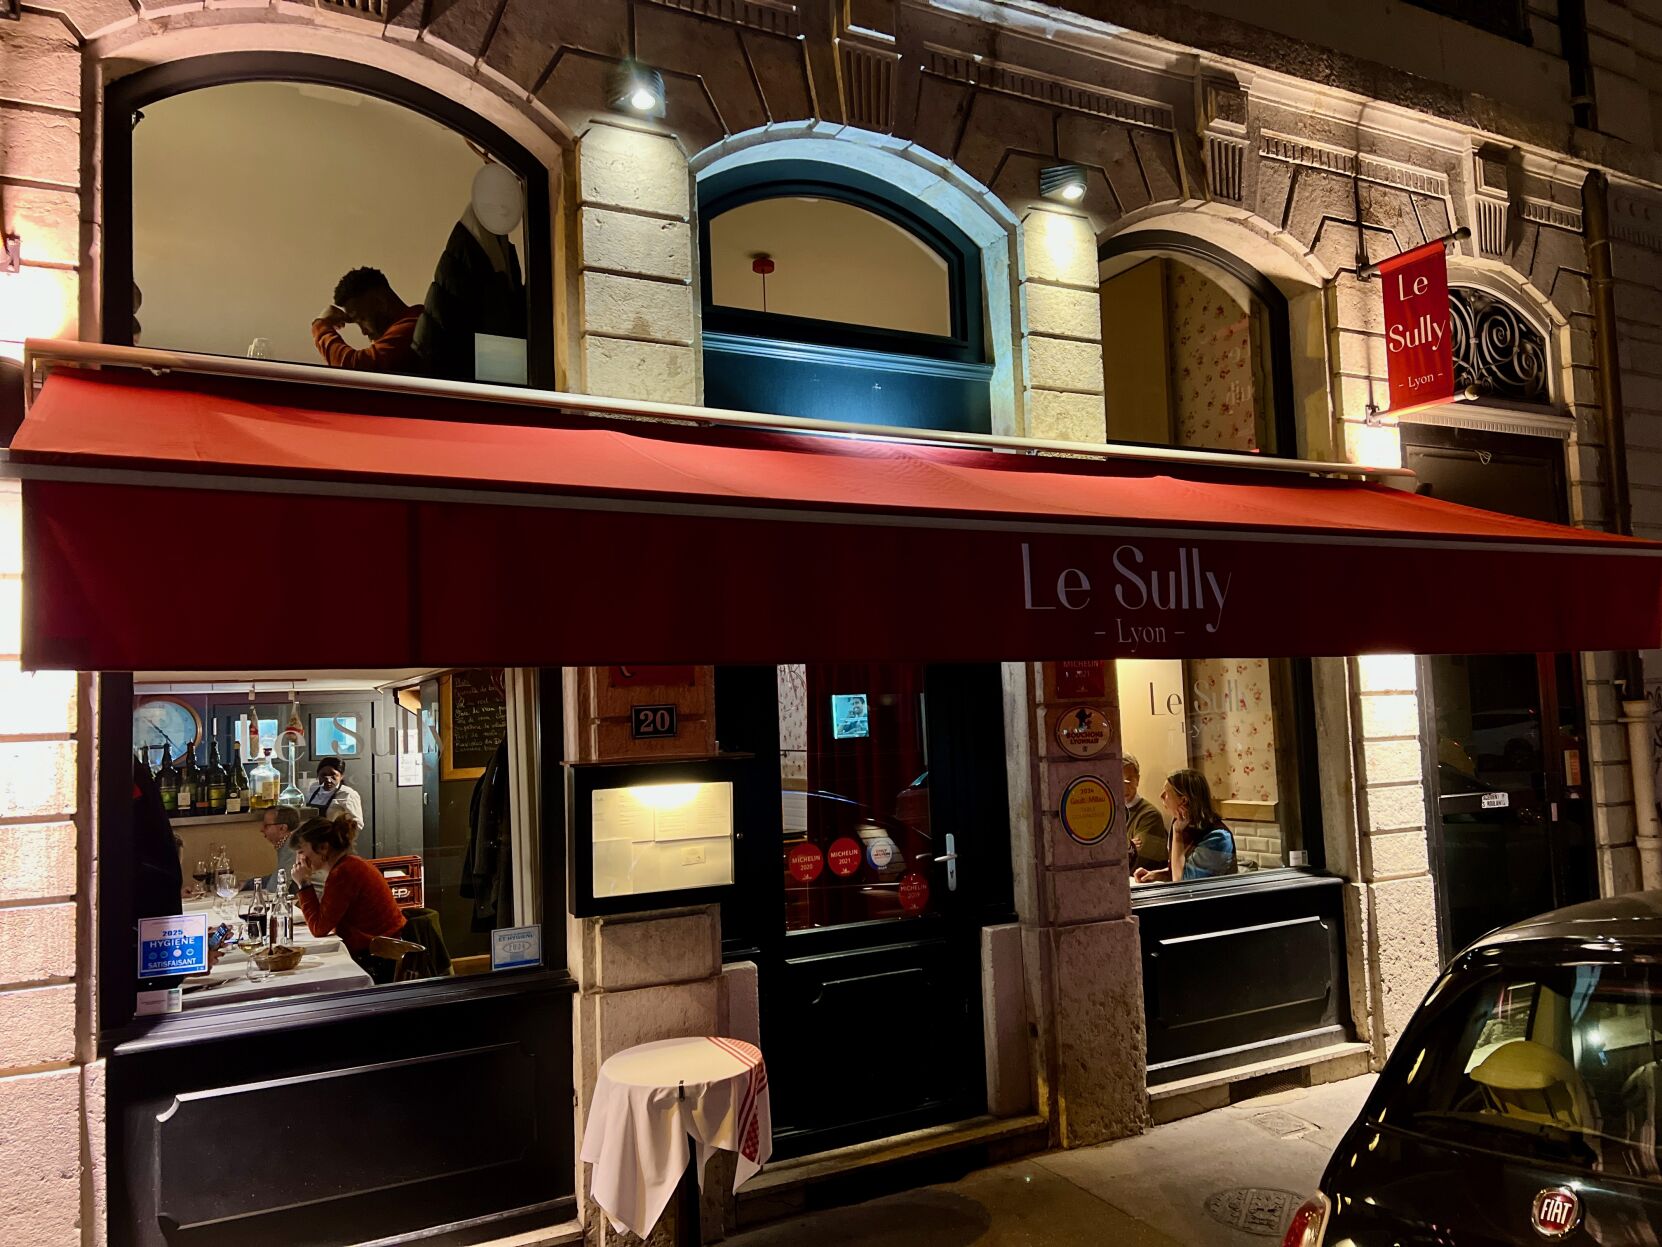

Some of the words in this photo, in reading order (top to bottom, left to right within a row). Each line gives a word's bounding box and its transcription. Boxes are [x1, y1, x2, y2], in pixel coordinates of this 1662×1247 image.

[1398, 274, 1428, 301] Le
[1389, 314, 1446, 353] Sully
[1408, 373, 1434, 390] Lyon
[1021, 543, 1092, 611] Le
[1112, 545, 1232, 633] Sully
[1117, 618, 1167, 652] Lyon
[1149, 682, 1182, 716] Le
[639, 710, 670, 733] 20
[240, 713, 307, 764] Le
[330, 707, 445, 769] Sully
[791, 855, 821, 864] MICHELIN
[830, 849, 859, 858] MICHELIN
[838, 857, 851, 865] 2021
[900, 883, 927, 892] MICHELIN
[162, 929, 184, 937] 2025
[147, 957, 197, 969] SATISFAISANT
[1540, 1198, 1573, 1225] FIAT
